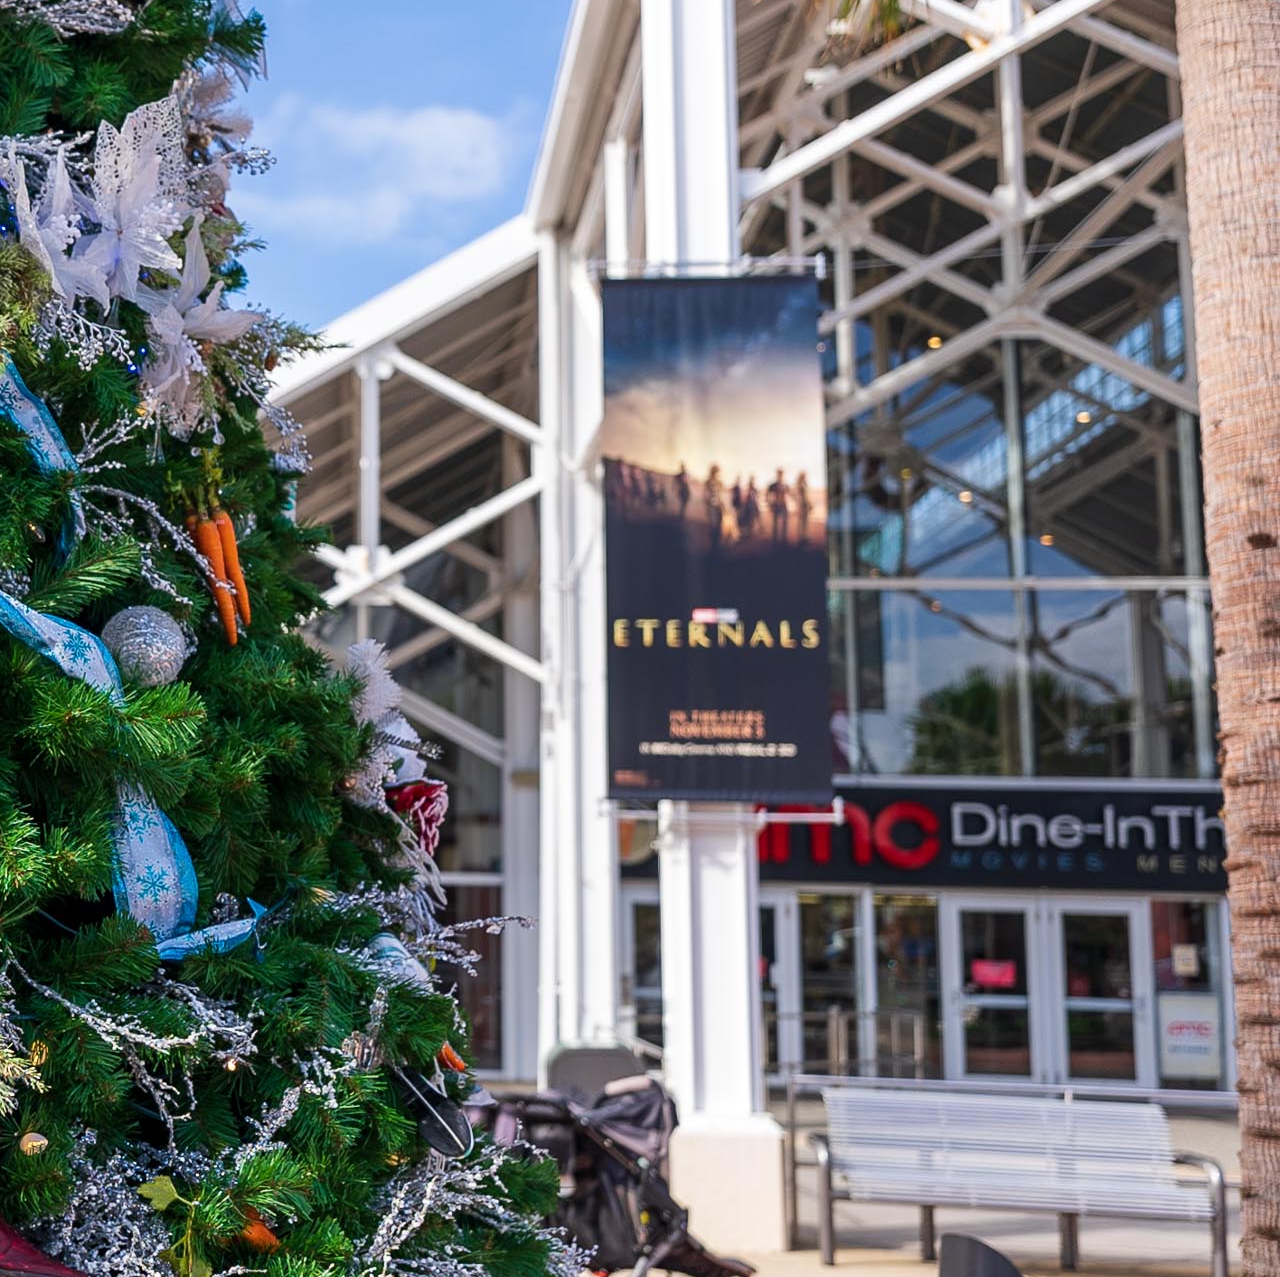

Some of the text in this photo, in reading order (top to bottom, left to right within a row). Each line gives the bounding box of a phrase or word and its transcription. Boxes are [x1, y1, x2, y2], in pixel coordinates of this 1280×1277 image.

[613, 618, 821, 649] ETERNALS
[758, 801, 941, 869] mc
[949, 851, 1104, 872] MOVIES
